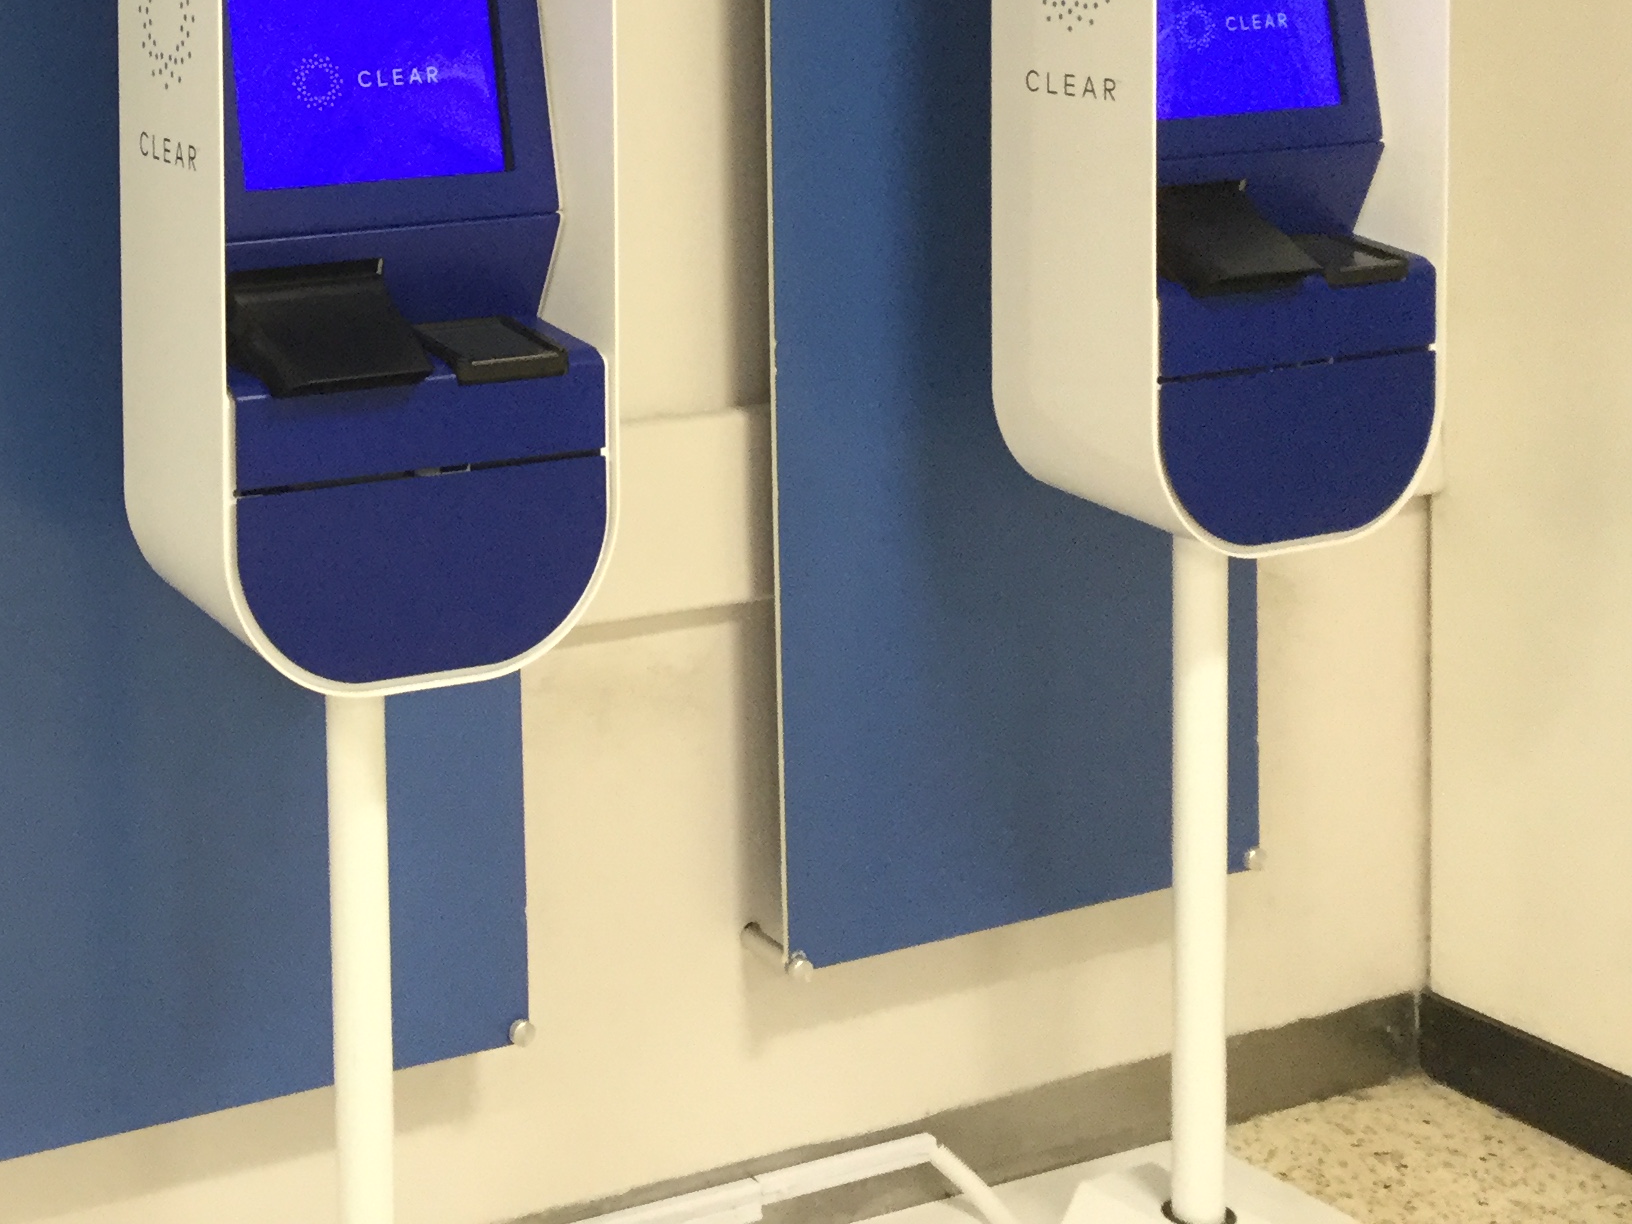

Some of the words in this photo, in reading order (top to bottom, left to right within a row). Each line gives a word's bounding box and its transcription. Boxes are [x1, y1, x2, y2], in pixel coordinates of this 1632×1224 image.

[1224, 11, 1289, 32] CLEAR
[356, 64, 442, 89] CLEAR
[1025, 69, 1117, 102] CLEAR
[139, 130, 197, 172] CLEAR
